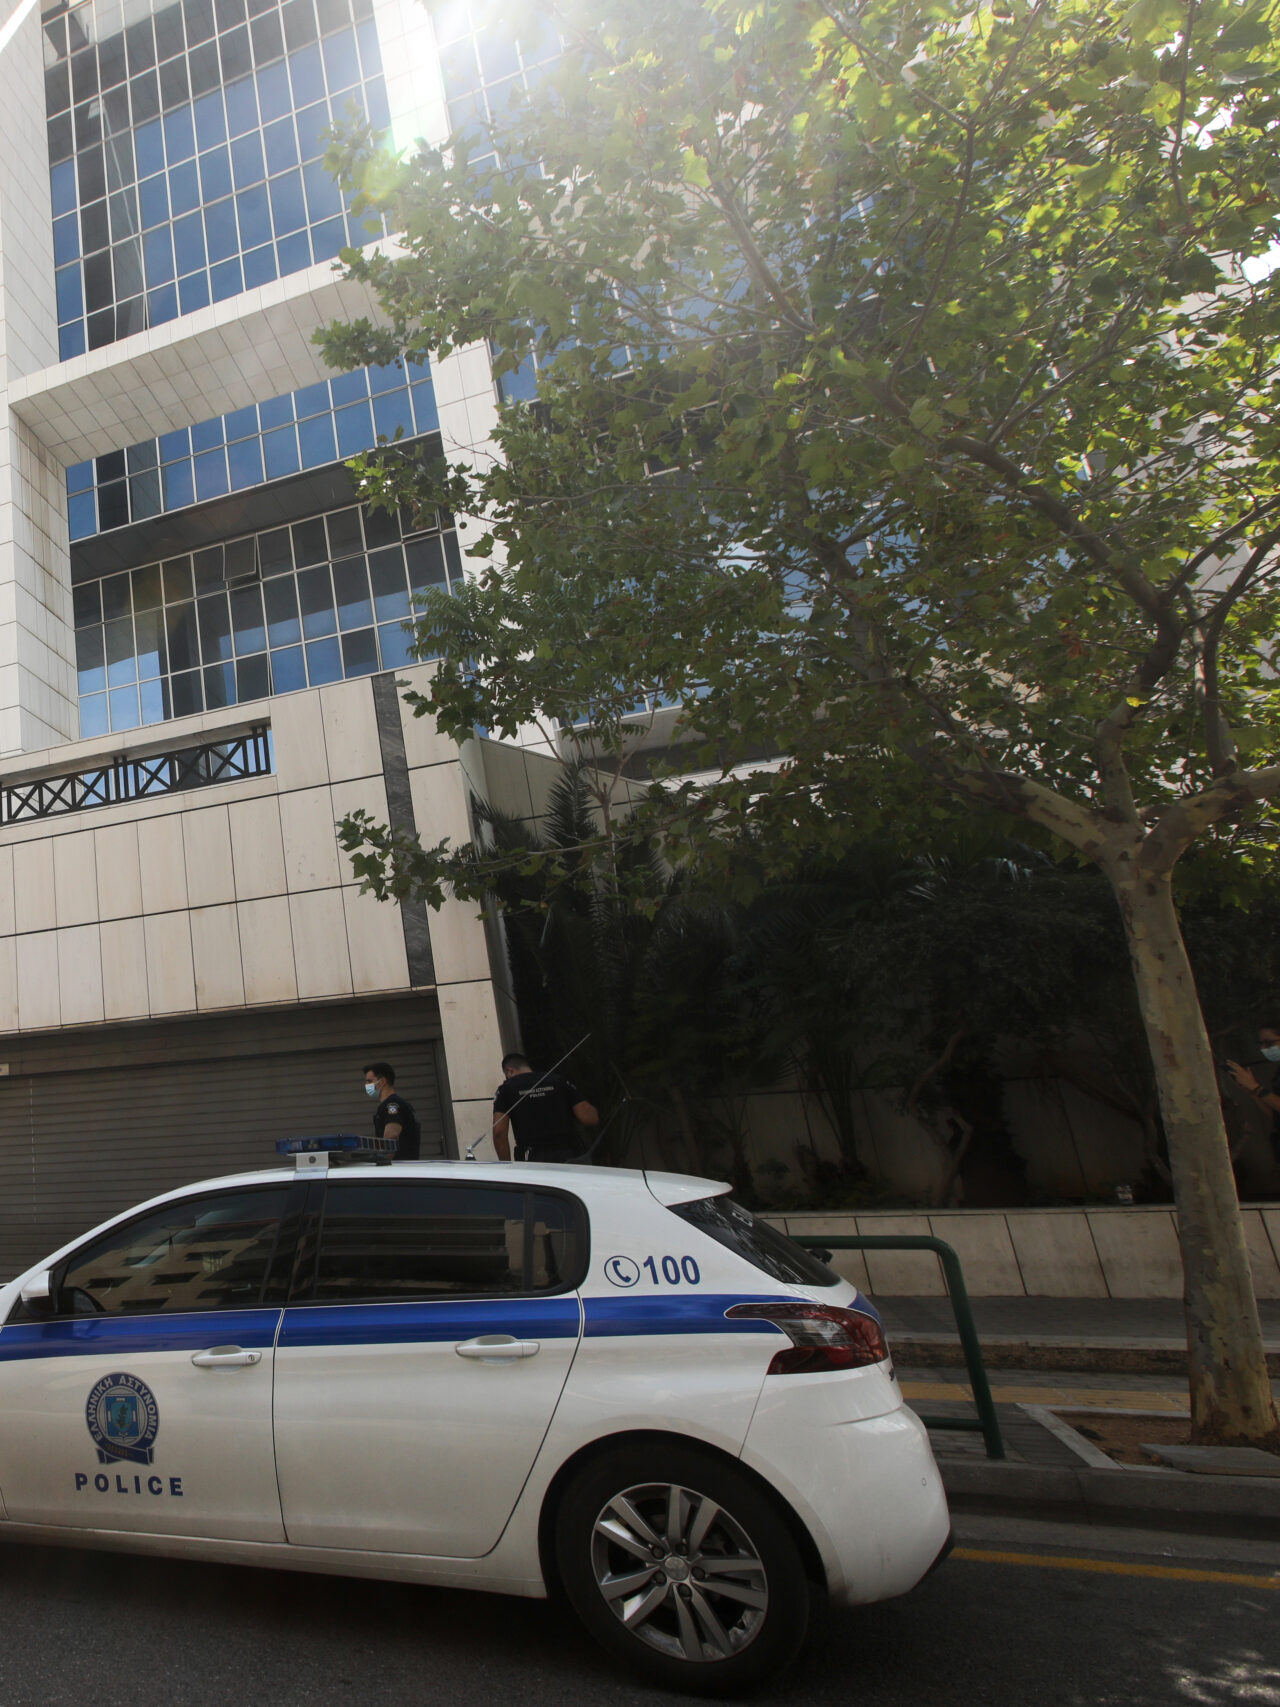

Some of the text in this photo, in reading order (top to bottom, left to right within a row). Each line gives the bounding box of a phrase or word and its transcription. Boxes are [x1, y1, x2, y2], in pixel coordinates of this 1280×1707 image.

[643, 1256, 700, 1285] 100
[88, 1375, 156, 1441] ΕΛΛΗΝΙΚΗ ΑΣΤΥΝΟΜΙΑ
[75, 1473, 183, 1496] POLICE
